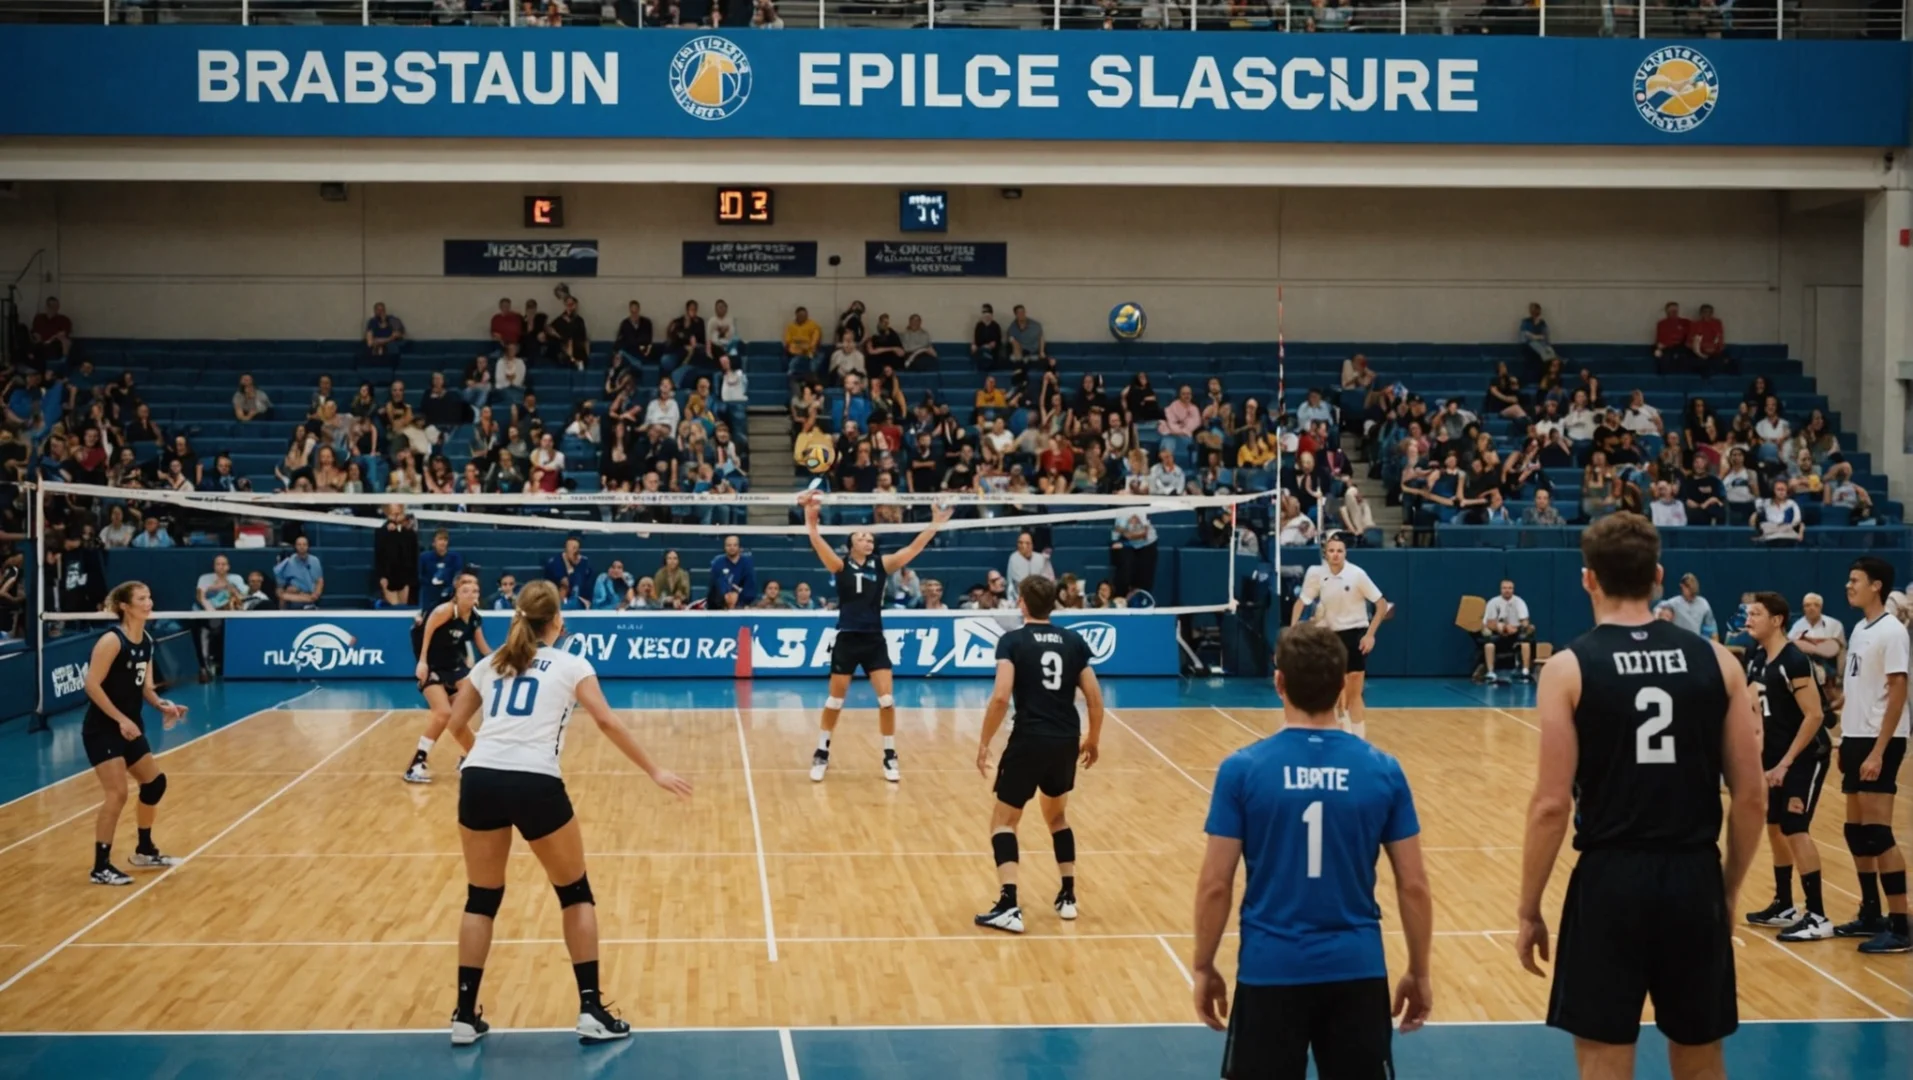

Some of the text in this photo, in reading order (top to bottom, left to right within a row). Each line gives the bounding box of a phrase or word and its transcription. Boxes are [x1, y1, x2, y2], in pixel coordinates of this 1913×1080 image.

[198, 50, 619, 105] BRABSTAUN
[799, 52, 1059, 108] EPILCE
[490, 676, 539, 717] 10
[1635, 686, 1676, 764] 2
[1302, 801, 1323, 877] 1
